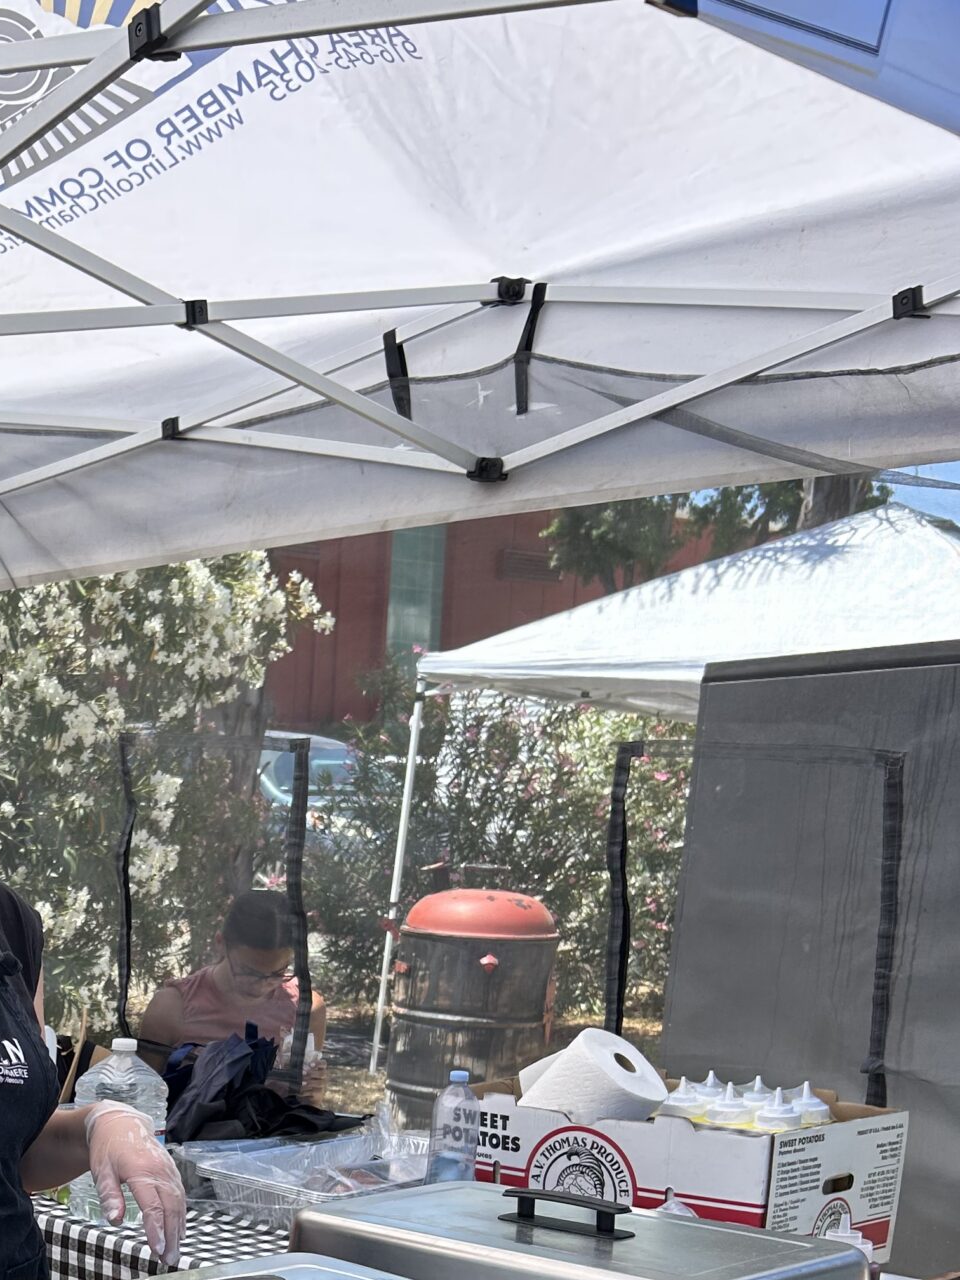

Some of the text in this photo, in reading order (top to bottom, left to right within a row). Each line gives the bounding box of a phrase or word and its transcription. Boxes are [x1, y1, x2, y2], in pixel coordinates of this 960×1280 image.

[453, 1106, 510, 1131] SWEET
[442, 1123, 521, 1153] POTATOES
[779, 1133, 825, 1149] SWEET POTATOES
[540, 1135, 588, 1163] THOMAS
[590, 1140, 630, 1198] PRODUCE
